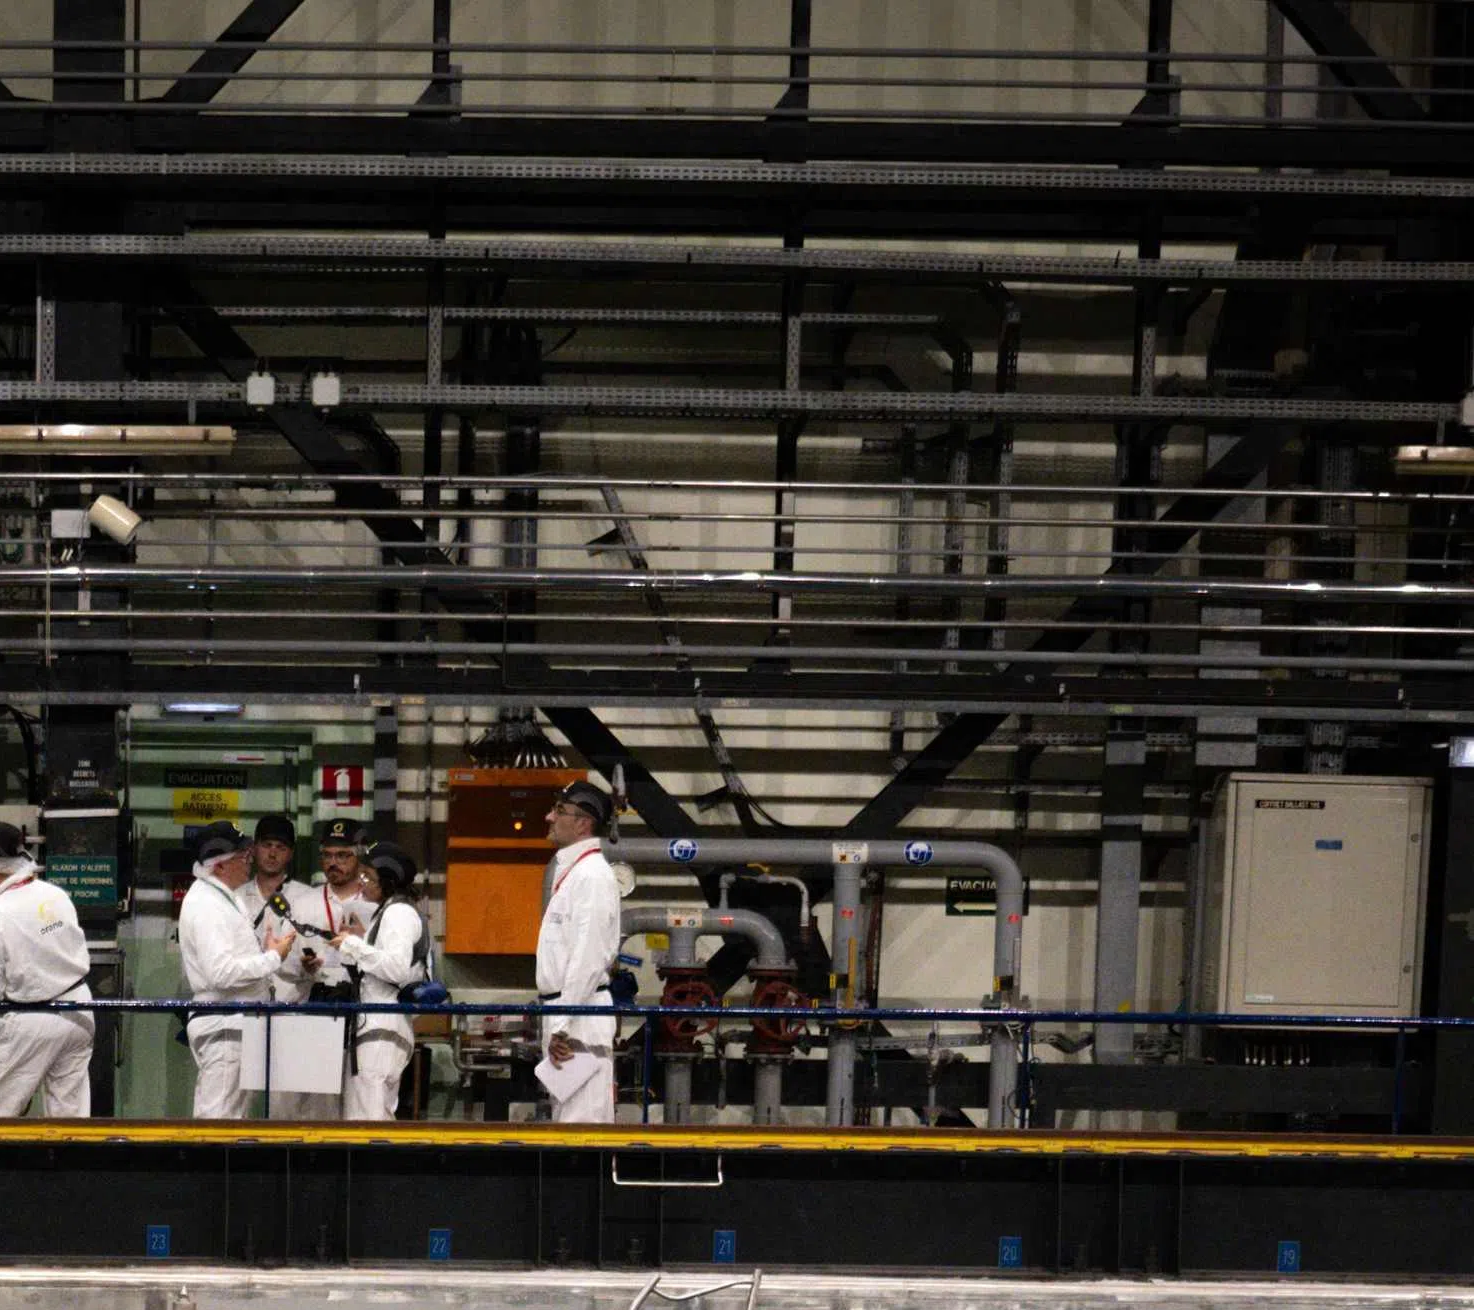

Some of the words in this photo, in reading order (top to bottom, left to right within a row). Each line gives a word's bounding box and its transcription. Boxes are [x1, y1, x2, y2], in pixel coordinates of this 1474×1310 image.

[168, 771, 245, 785] EVACUATION
[151, 1232, 166, 1250] 23
[432, 1236, 447, 1254] 22
[718, 1238, 732, 1256] 21
[1003, 1246, 1018, 1262] 20
[1282, 1249, 1296, 1266] 19
